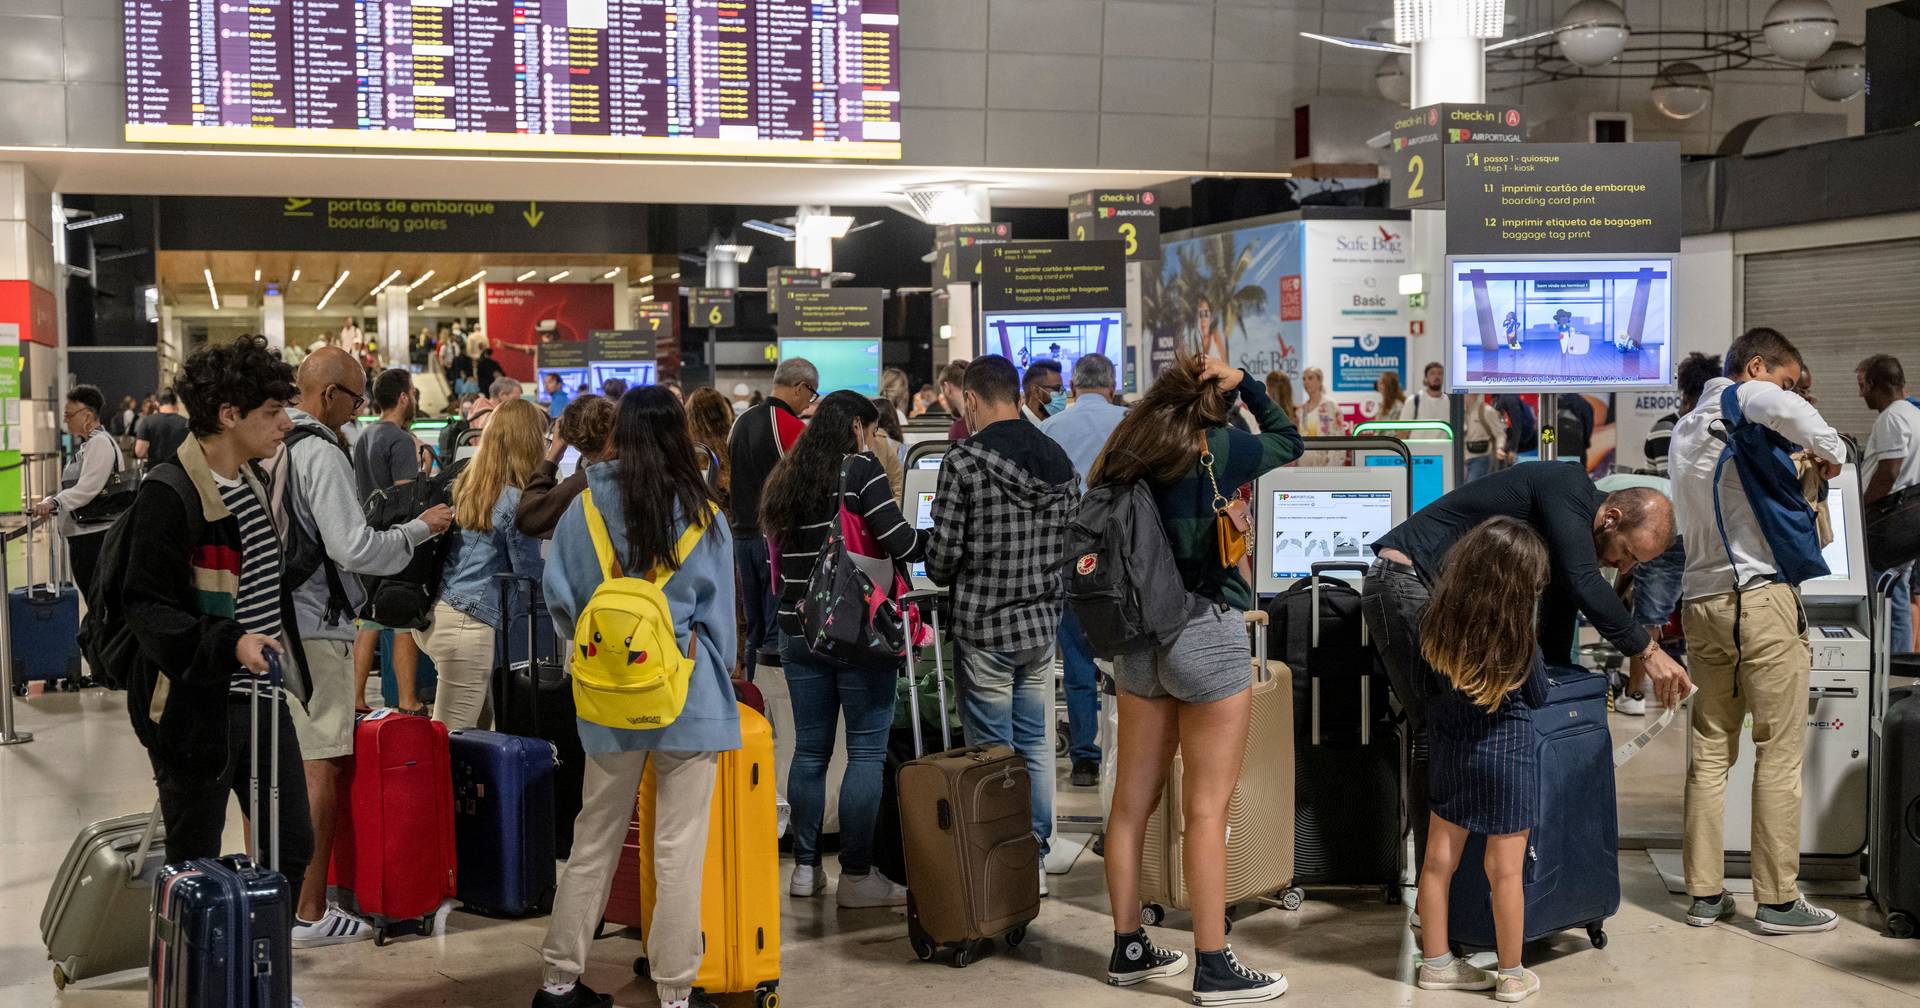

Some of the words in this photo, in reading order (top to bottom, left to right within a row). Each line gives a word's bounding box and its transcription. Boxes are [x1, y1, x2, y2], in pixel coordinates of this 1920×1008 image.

[1451, 110, 1494, 121] check-in
[1448, 128, 1471, 143] TAP
[1484, 156, 1508, 164] passo
[1521, 155, 1560, 164] quiosque
[1484, 165, 1502, 173] step
[1514, 164, 1535, 172] kiosk
[1408, 155, 1424, 199] 2
[1484, 184, 1494, 193] 1.1
[1502, 183, 1542, 194] imprimir
[1545, 183, 1578, 193] cartão
[1580, 184, 1592, 192] de
[1595, 183, 1646, 193] embarque
[1100, 193, 1135, 202] check-in
[1502, 196, 1546, 206] boarding
[1548, 196, 1570, 205] card
[1572, 196, 1596, 206] print
[328, 200, 381, 214] portas
[386, 200, 406, 213] de
[410, 201, 495, 215] embarque
[1098, 207, 1116, 218] TAP
[328, 216, 400, 232] boarding
[403, 218, 448, 232] gates
[1484, 218, 1496, 227] 1.2
[1502, 217, 1543, 229] imprimir
[1546, 217, 1587, 228] etiqueta
[1589, 218, 1601, 227] de
[1604, 217, 1652, 228] bagagem
[1119, 223, 1138, 256] 3
[1502, 231, 1546, 241] baggage
[1550, 231, 1566, 240] tag
[1568, 230, 1591, 240] print
[1336, 236, 1368, 251] Safe
[1372, 236, 1402, 254] Bag
[1015, 273, 1043, 281] boarding
[1282, 294, 1300, 306] LOVE
[1353, 294, 1386, 306] Basic
[709, 305, 722, 324] 6
[649, 318, 660, 331] 7
[1241, 353, 1269, 375] Safe
[1270, 351, 1299, 380] Bag
[1340, 353, 1399, 367] Premium
